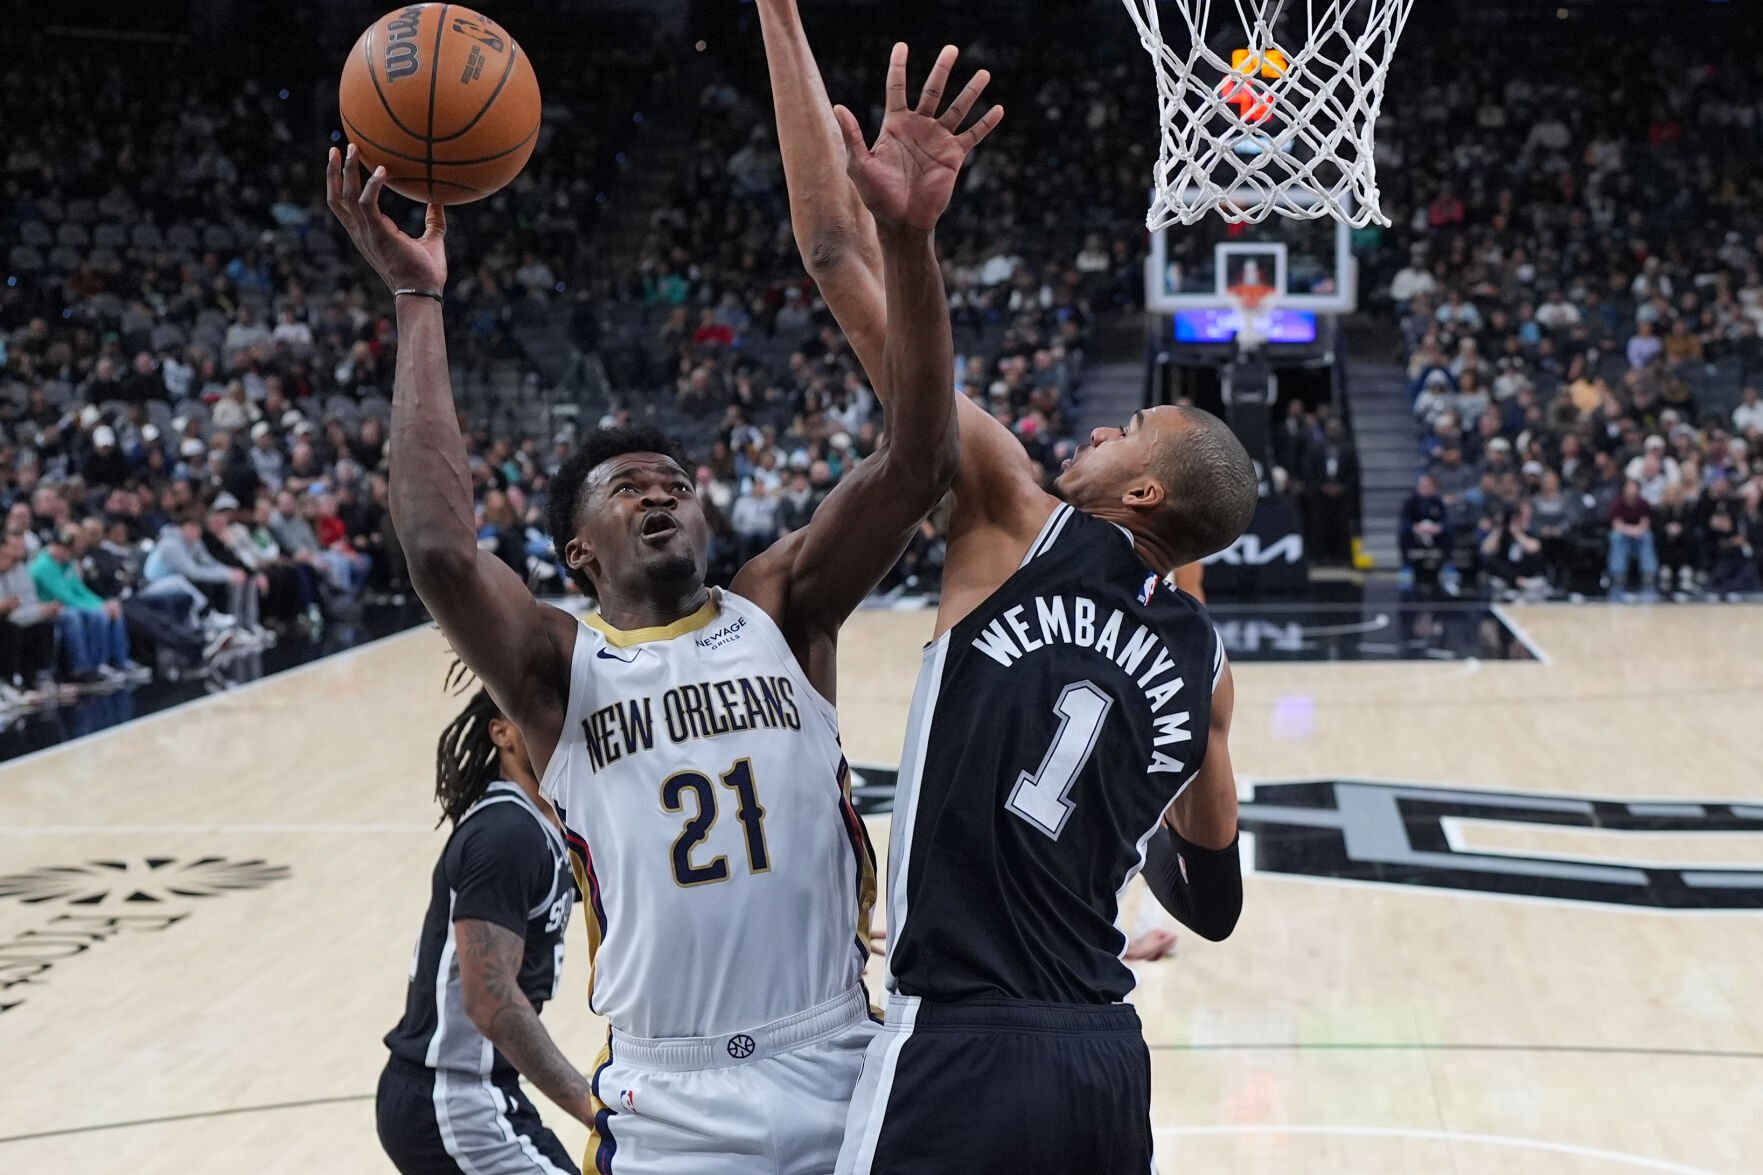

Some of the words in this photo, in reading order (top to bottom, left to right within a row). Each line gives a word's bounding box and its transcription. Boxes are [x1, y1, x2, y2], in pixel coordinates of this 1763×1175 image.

[385, 3, 423, 83] Wils
[695, 616, 747, 648] NEWAGE
[711, 633, 741, 650] GRILLS
[582, 696, 654, 775] NEW
[663, 675, 801, 744] ORLEANS
[971, 595, 1192, 774] WEMBANYAMA
[1004, 679, 1115, 842] 1
[660, 757, 772, 888] 21
